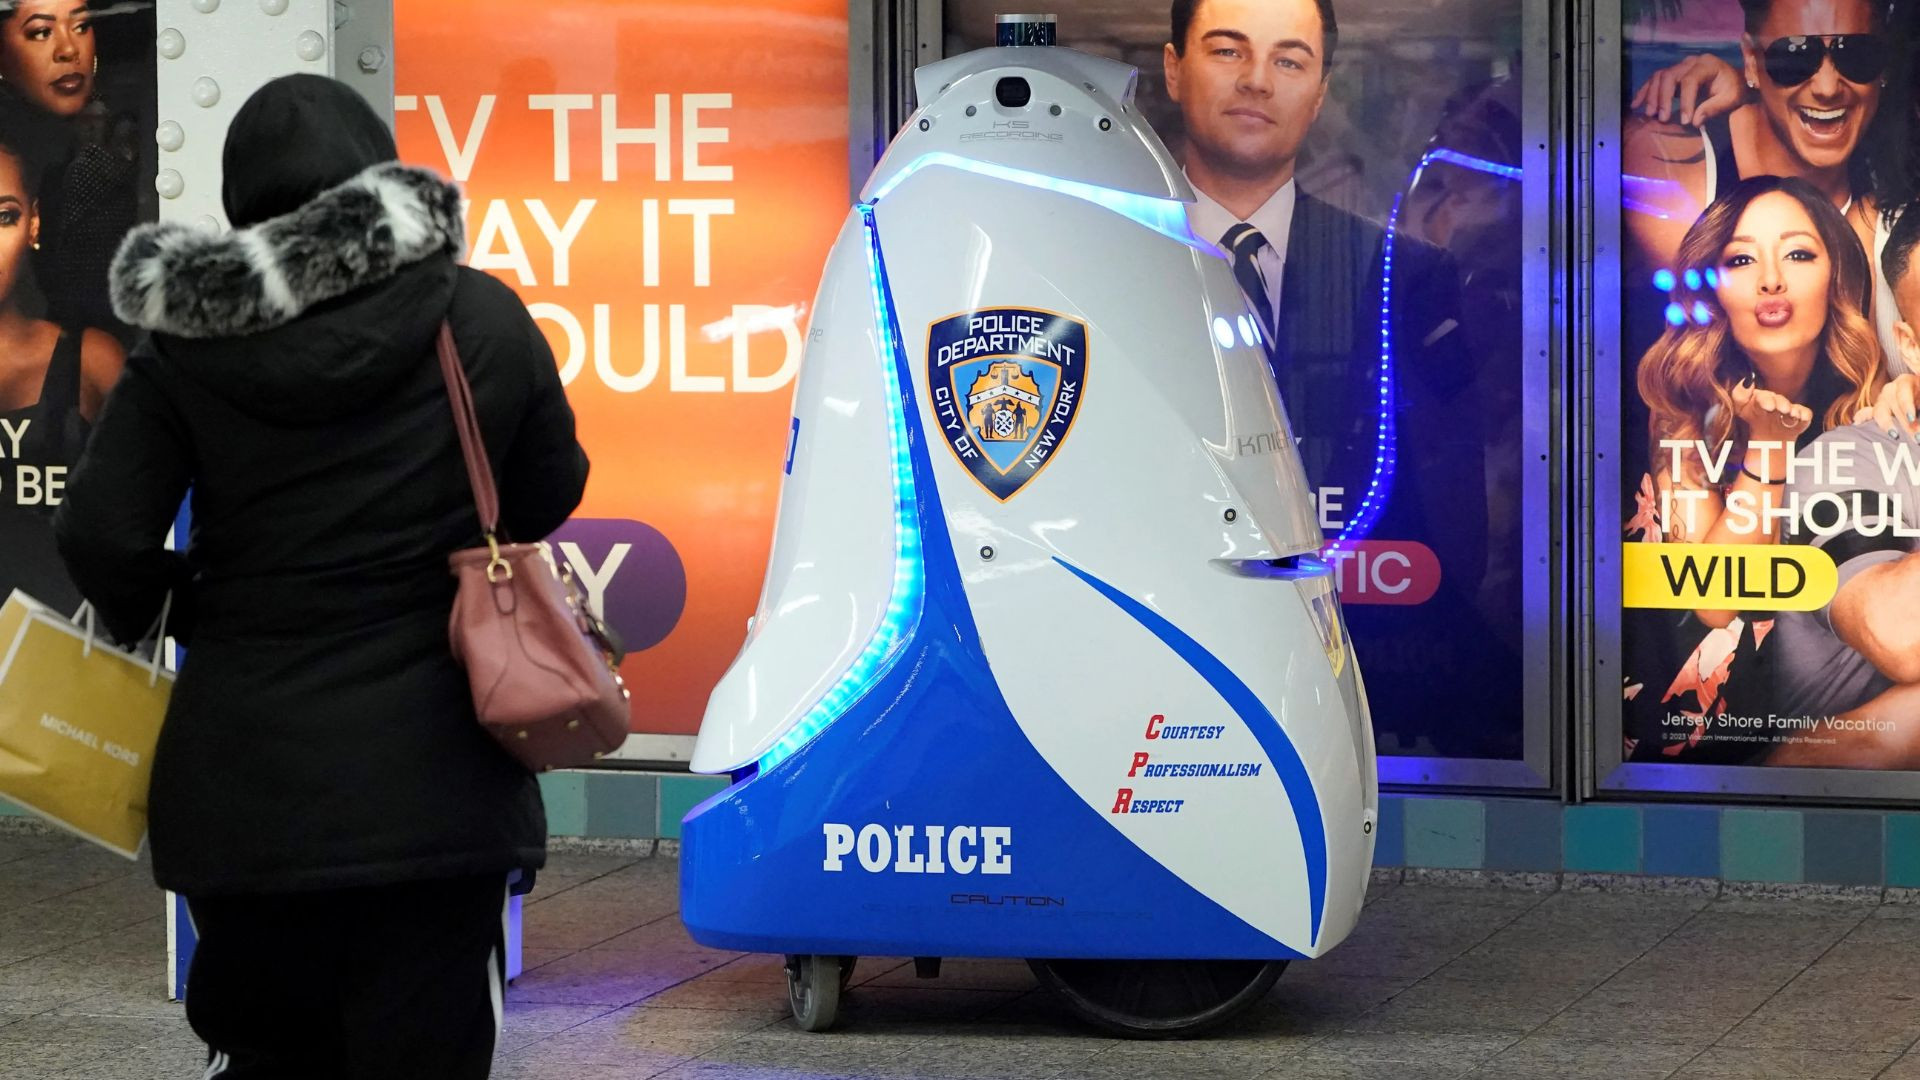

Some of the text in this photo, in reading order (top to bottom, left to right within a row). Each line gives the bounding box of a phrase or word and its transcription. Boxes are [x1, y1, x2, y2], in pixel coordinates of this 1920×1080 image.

[528, 93, 734, 182] THE
[463, 199, 734, 287] AY IT
[969, 315, 1044, 335] POLICE
[526, 302, 803, 393] OULD
[937, 334, 1075, 367] DEPARTMENT
[935, 386, 978, 459] CITY OF
[1025, 380, 1077, 469] NEW YORK
[1660, 440, 1733, 483] TV
[1748, 440, 1856, 485] THE
[16, 465, 68, 505] BE
[1309, 487, 1344, 529] E
[1661, 490, 1920, 538] IT SHOUL
[1322, 550, 1411, 594] TIC
[1661, 555, 1806, 599] WILD
[39, 712, 139, 767] MICHAEL KORS
[1661, 711, 1896, 733] Jersey Shore Family Vacation
[1669, 732, 1686, 740] 2023
[1714, 734, 1757, 742] International
[1781, 736, 1803, 744] Rights
[823, 823, 1012, 875] POLICE
[951, 894, 1064, 906] CAUTION
